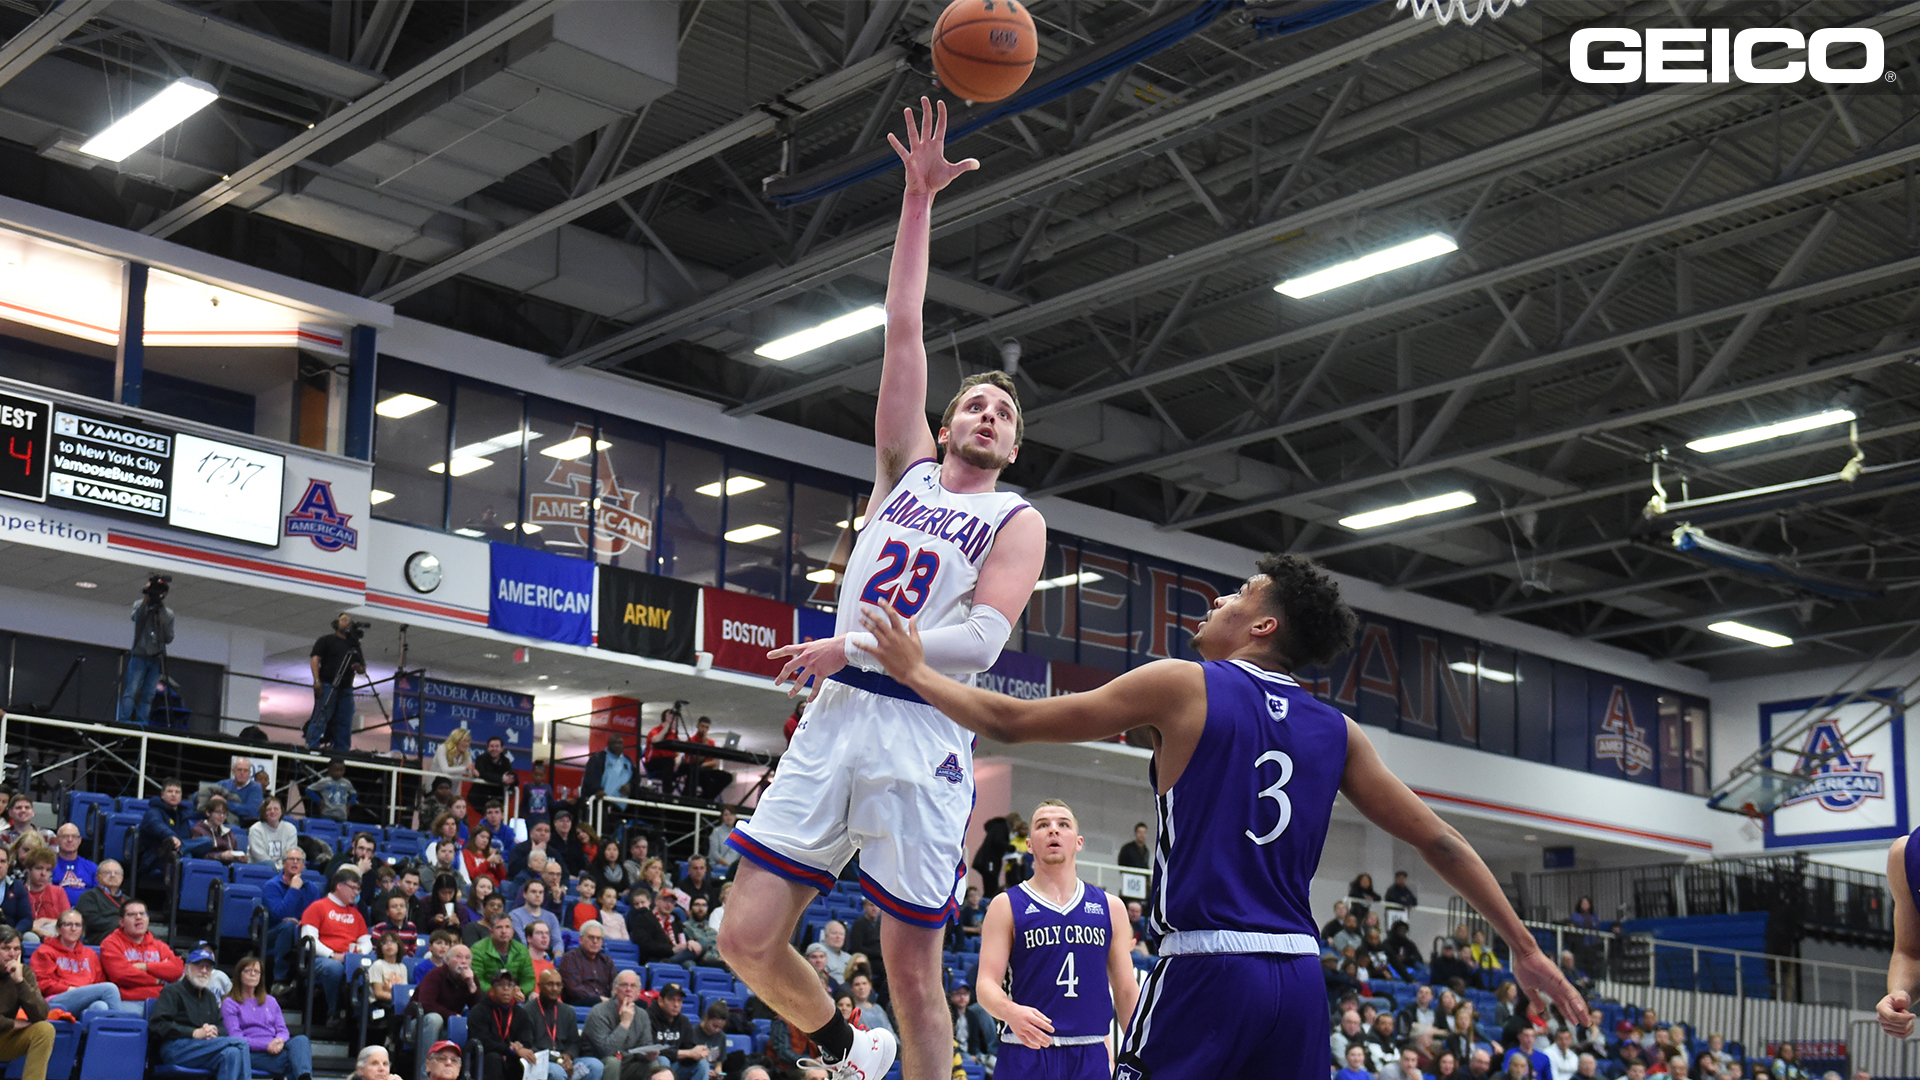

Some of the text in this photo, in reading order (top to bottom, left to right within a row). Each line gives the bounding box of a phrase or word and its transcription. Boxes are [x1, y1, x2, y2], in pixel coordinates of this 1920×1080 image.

[0, 405, 38, 431] EST
[81, 423, 165, 452] VAMOOSE
[9, 436, 33, 476] 4
[53, 454, 164, 490] VamooseBus.com
[59, 440, 161, 475] to New York City
[197, 450, 266, 490] 1757
[75, 482, 161, 512] VAMOOSE
[290, 521, 354, 543] AMERICAN
[535, 501, 647, 540] AMERICAN
[878, 489, 993, 565] AMERICAN
[859, 537, 940, 619] 23
[498, 578, 590, 615] AMERICAN
[623, 603, 672, 631] ARMY
[722, 618, 777, 648] BOSTON
[418, 682, 515, 708] ENDER ARENA
[451, 705, 479, 719] EXIT
[495, 711, 531, 727] 107-115
[1245, 750, 1294, 846] 3
[1024, 925, 1105, 948] HOLY CROSS
[1056, 952, 1079, 998] 4
